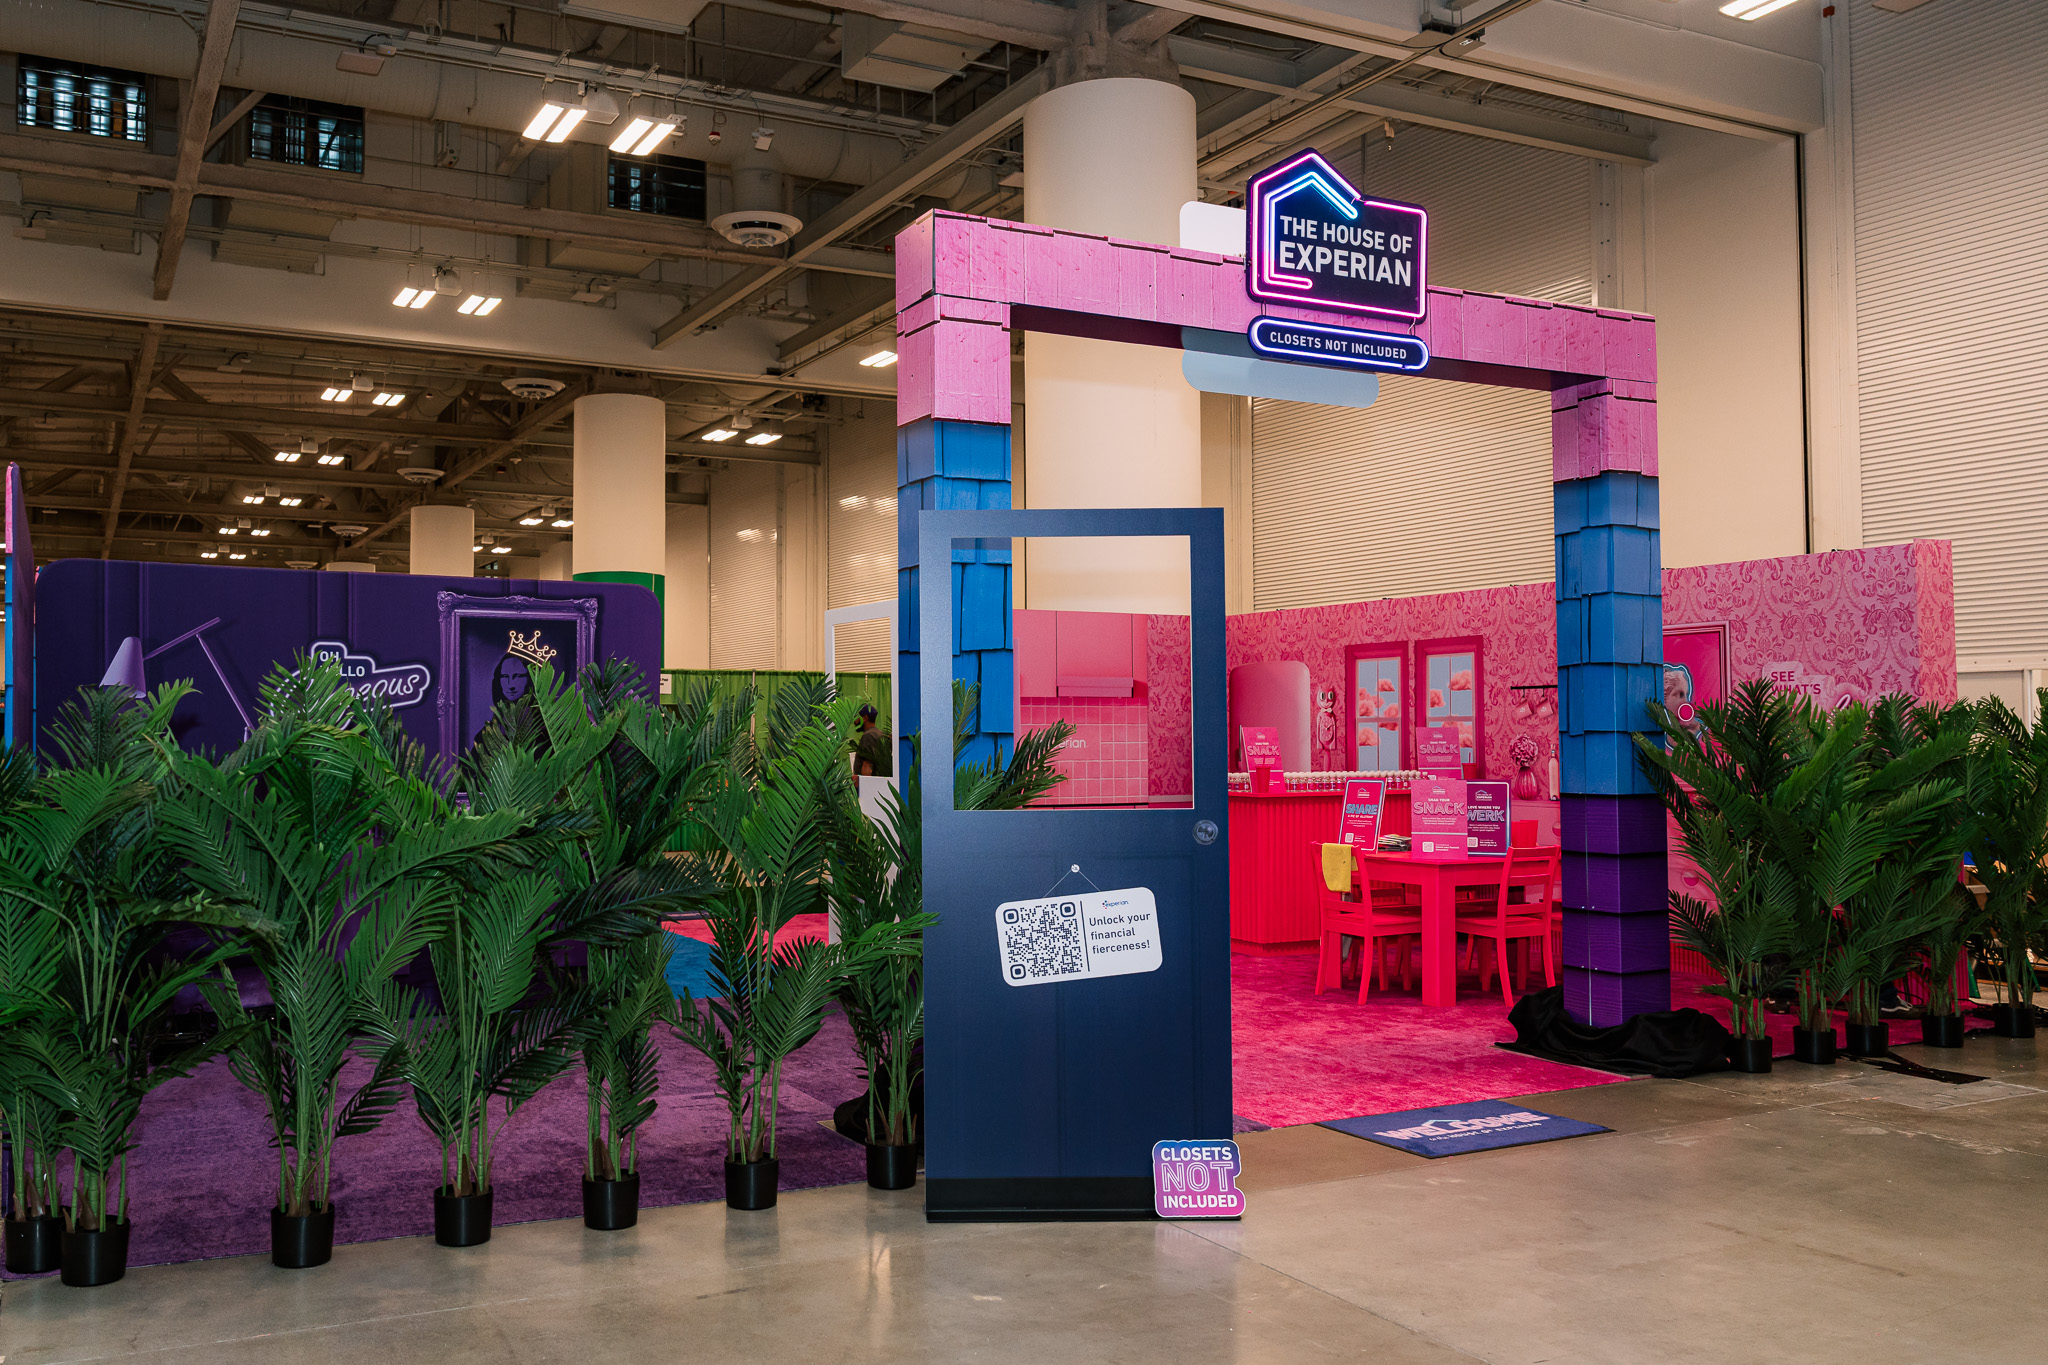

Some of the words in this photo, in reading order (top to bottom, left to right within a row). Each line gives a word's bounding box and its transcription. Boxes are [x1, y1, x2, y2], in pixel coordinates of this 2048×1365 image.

[1279, 215, 1318, 240] THE
[1323, 222, 1385, 251] HOUSE
[1389, 233, 1413, 255] OF
[1279, 240, 1412, 287] EXPERIAN
[1269, 331, 1322, 349] CLOSETS
[1325, 339, 1348, 352] NOT
[1351, 342, 1407, 360] INCLUDED
[320, 651, 340, 662] OH
[1770, 671, 1795, 682] SEE
[1247, 745, 1280, 756] SNACK
[1419, 744, 1459, 754] SNACK
[1345, 803, 1379, 815] SHARE
[1413, 802, 1465, 815] SNACK
[1089, 914, 1125, 927] Unlock
[1127, 913, 1151, 925] your
[1091, 927, 1136, 940] financial
[1092, 939, 1150, 954] fierceness!
[1374, 1111, 1551, 1140] WELCOME
[1160, 1147, 1233, 1161] CLOSETS
[1161, 1161, 1234, 1192] NOT
[1163, 1194, 1238, 1209] INCLUDED
